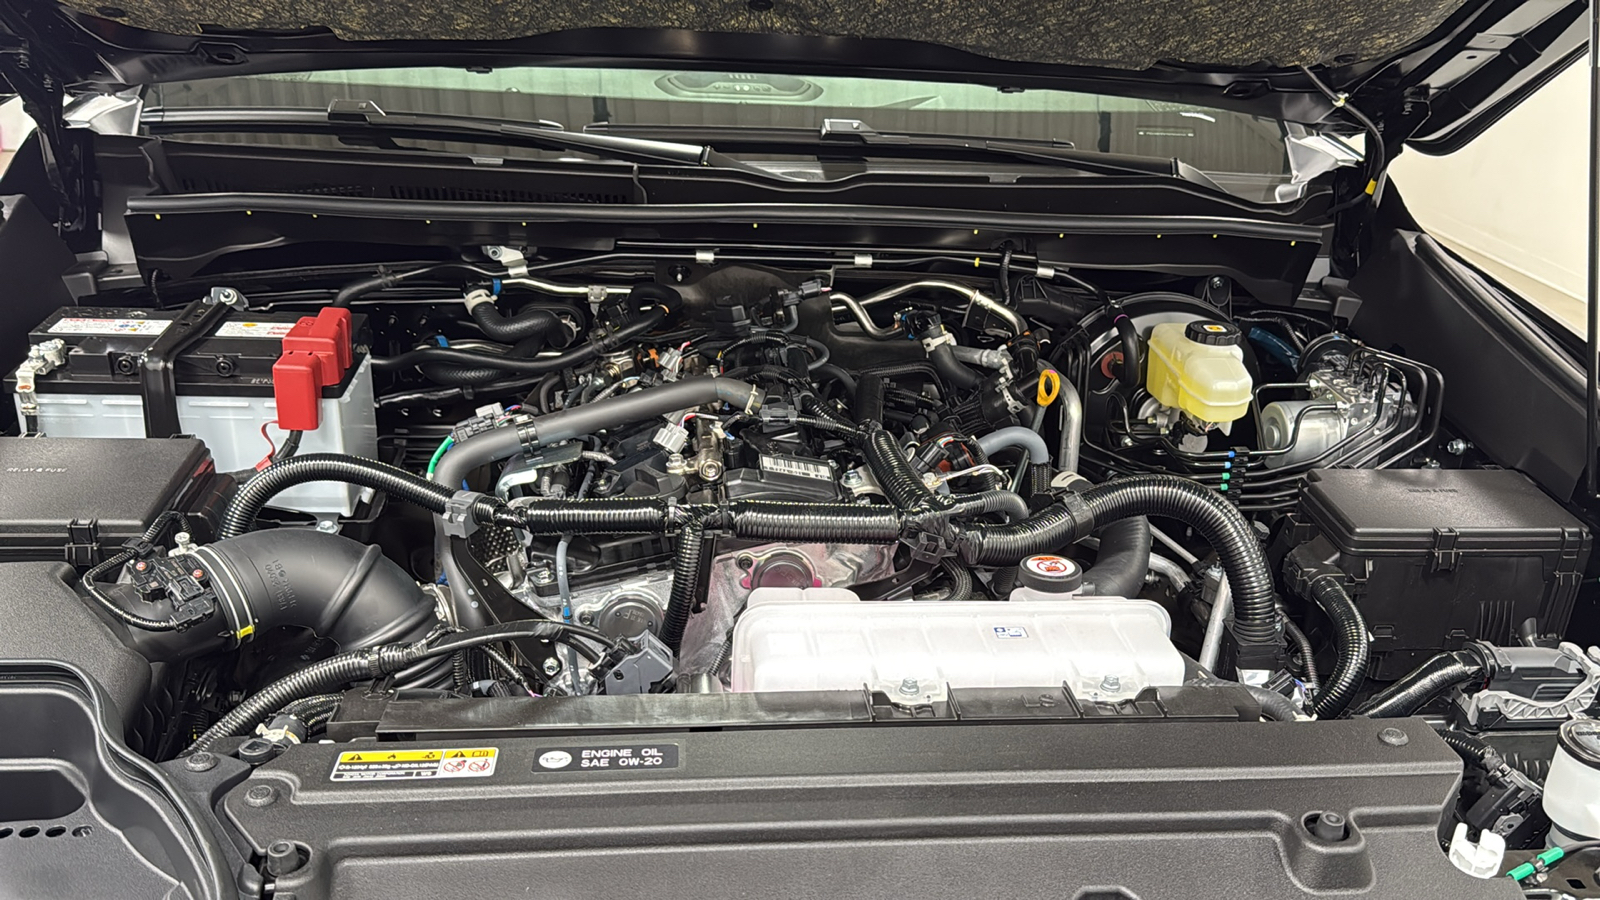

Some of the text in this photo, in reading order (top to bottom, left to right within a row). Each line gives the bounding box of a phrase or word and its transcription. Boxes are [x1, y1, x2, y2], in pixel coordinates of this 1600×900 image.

[581, 748, 663, 758] ENGINE OIL
[581, 757, 663, 767] SAE 0W-20
